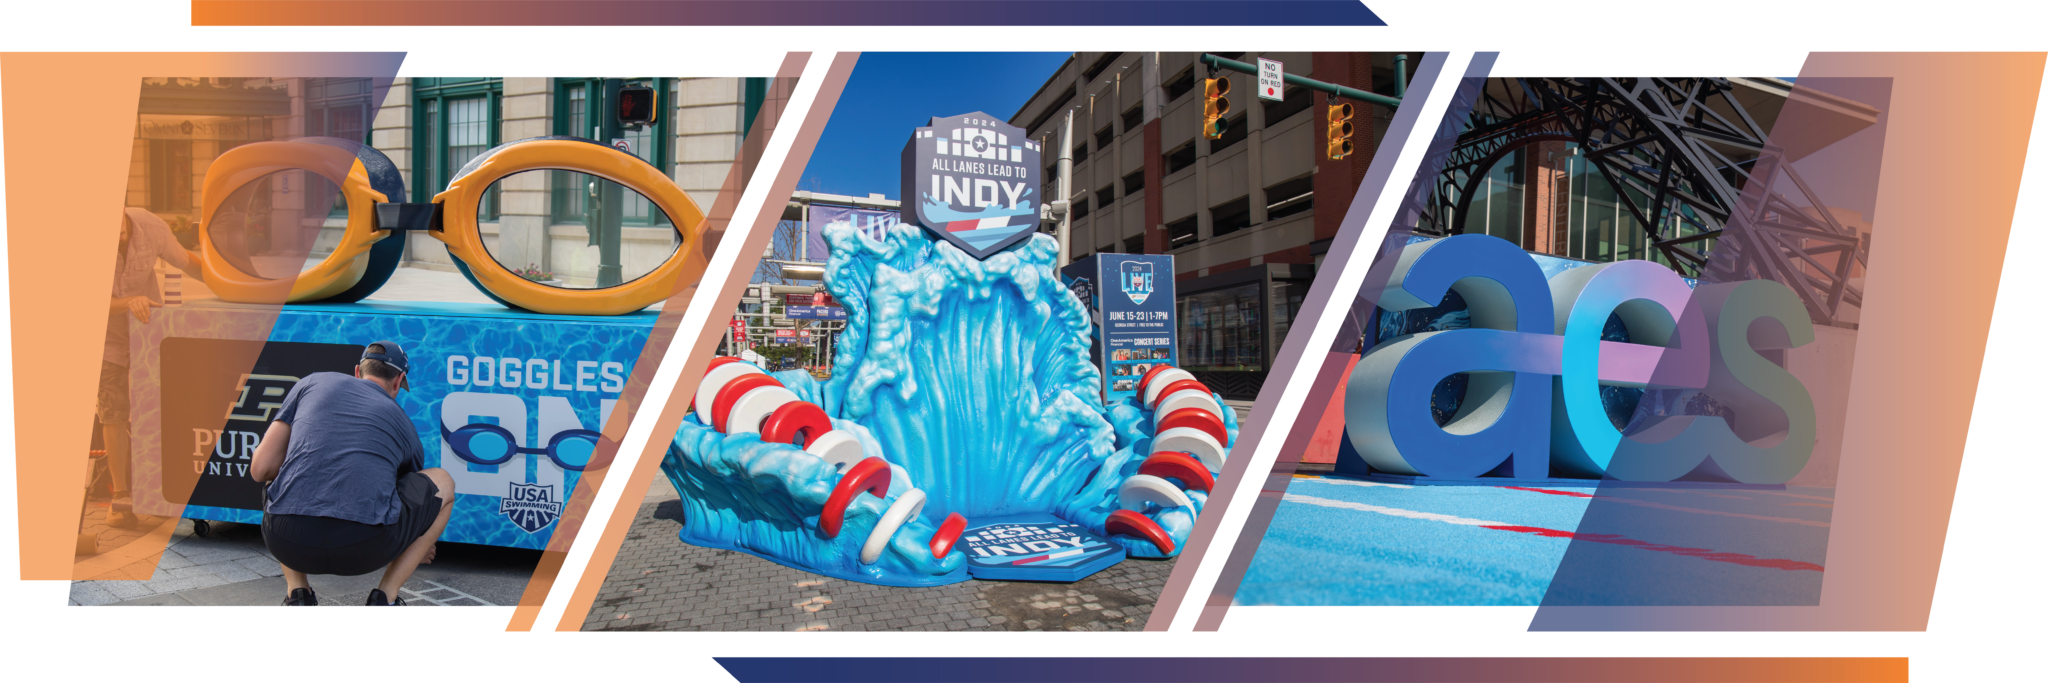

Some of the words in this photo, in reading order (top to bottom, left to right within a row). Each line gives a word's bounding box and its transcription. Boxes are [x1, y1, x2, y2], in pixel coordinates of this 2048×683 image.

[1264, 62, 1276, 71] NO
[1264, 71, 1278, 80] TURN
[964, 118, 996, 127] 2024
[932, 158, 950, 171] ALL
[953, 160, 985, 174] LANES
[988, 164, 1012, 177] LEAD
[1014, 166, 1027, 178] TO
[932, 174, 1026, 210] INDY
[1122, 272, 1154, 292] LIVE
[1110, 312, 1125, 320] JUNE
[1126, 312, 1144, 320] 15-23
[1149, 312, 1168, 320] 1-7PM
[446, 355, 624, 393] GOGGLES
[224, 373, 300, 422] P
[441, 391, 629, 505] ON
[514, 487, 549, 502] USA
[505, 500, 556, 512] SWIMMING
[972, 536, 1084, 557] INDY
[994, 536, 1030, 545] LANES
[1030, 533, 1060, 541] LEAD
